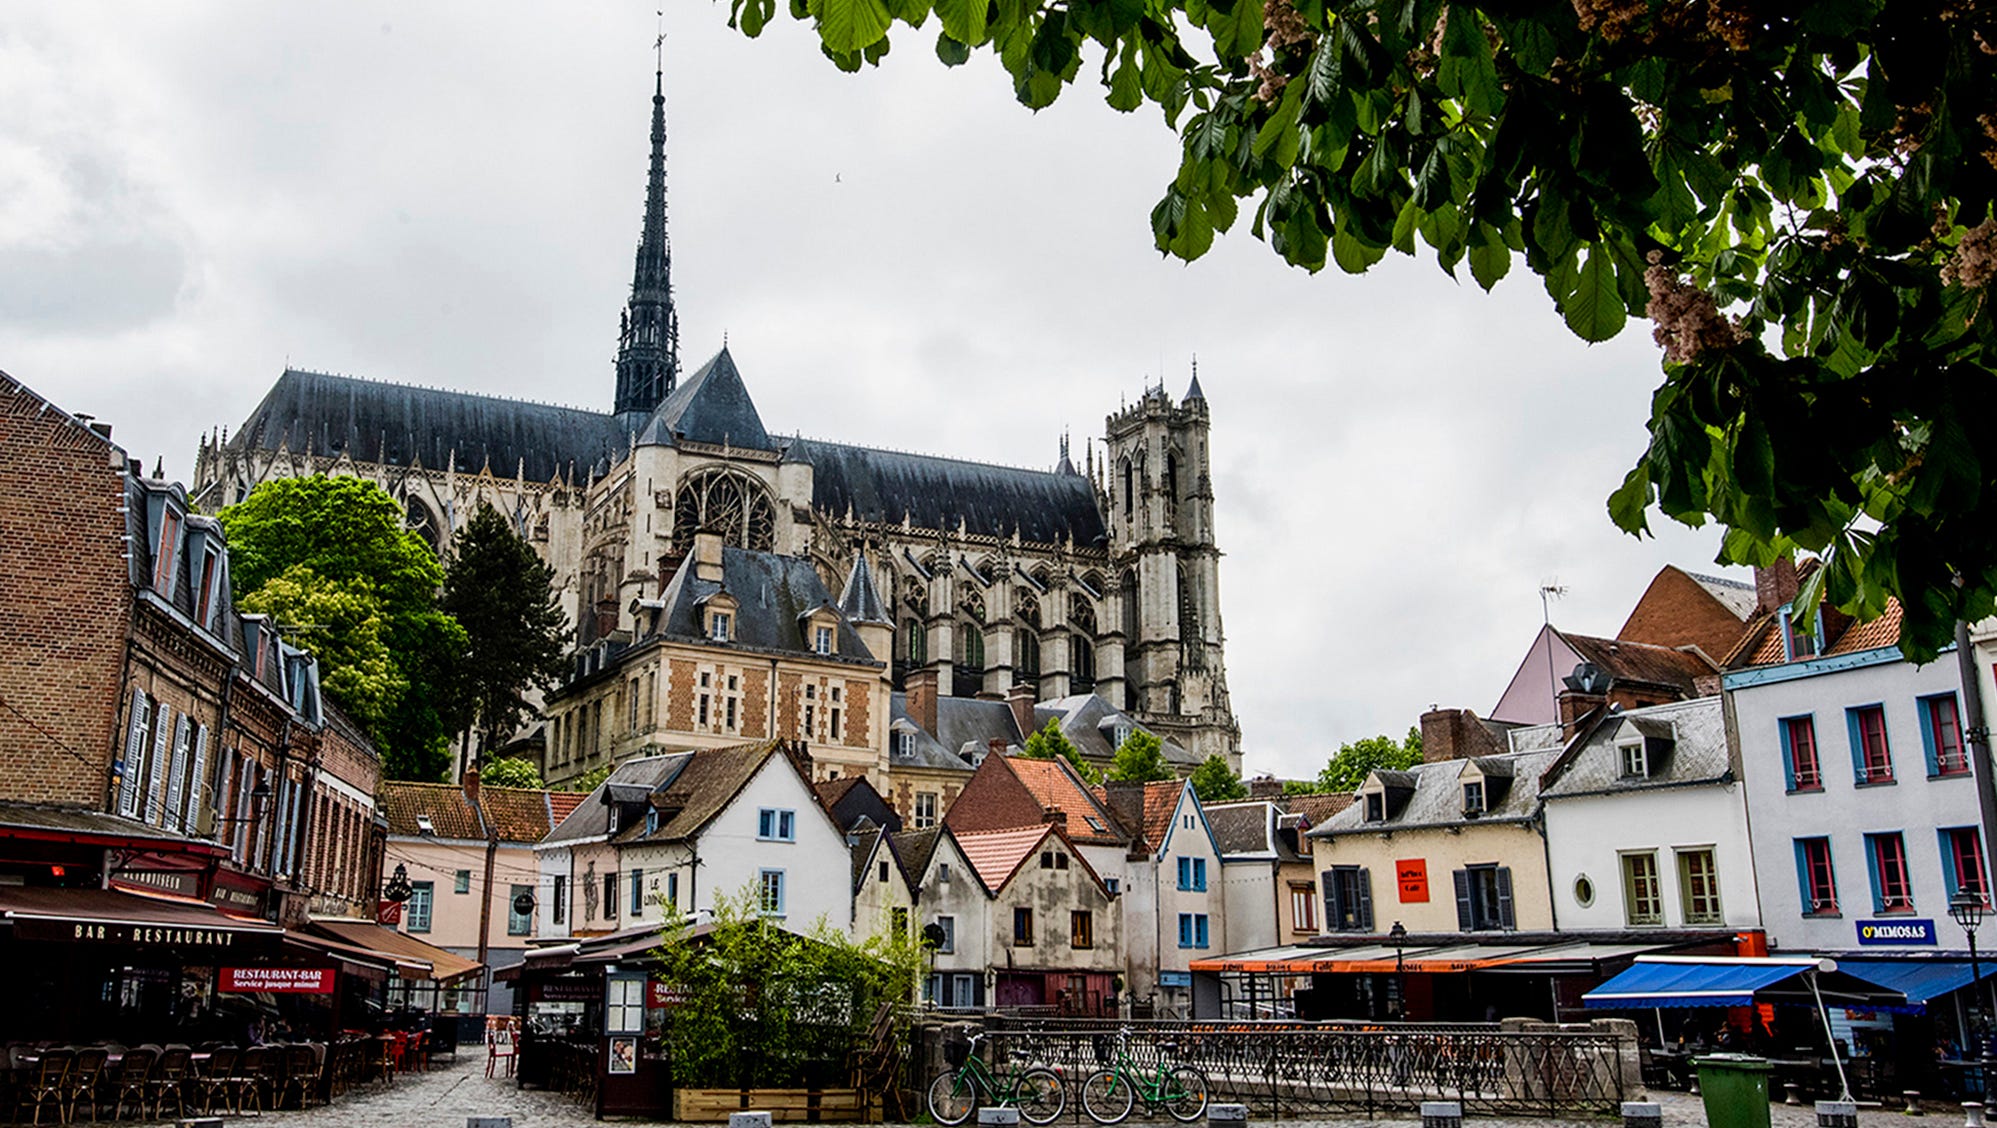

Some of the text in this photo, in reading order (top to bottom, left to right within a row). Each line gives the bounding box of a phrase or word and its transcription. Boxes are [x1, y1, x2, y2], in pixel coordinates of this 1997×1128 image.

[74, 924, 233, 946] BAR RESTAURANT
[1862, 925, 1926, 938] O'MIMOSAS
[233, 980, 320, 989] Service jusque minuit
